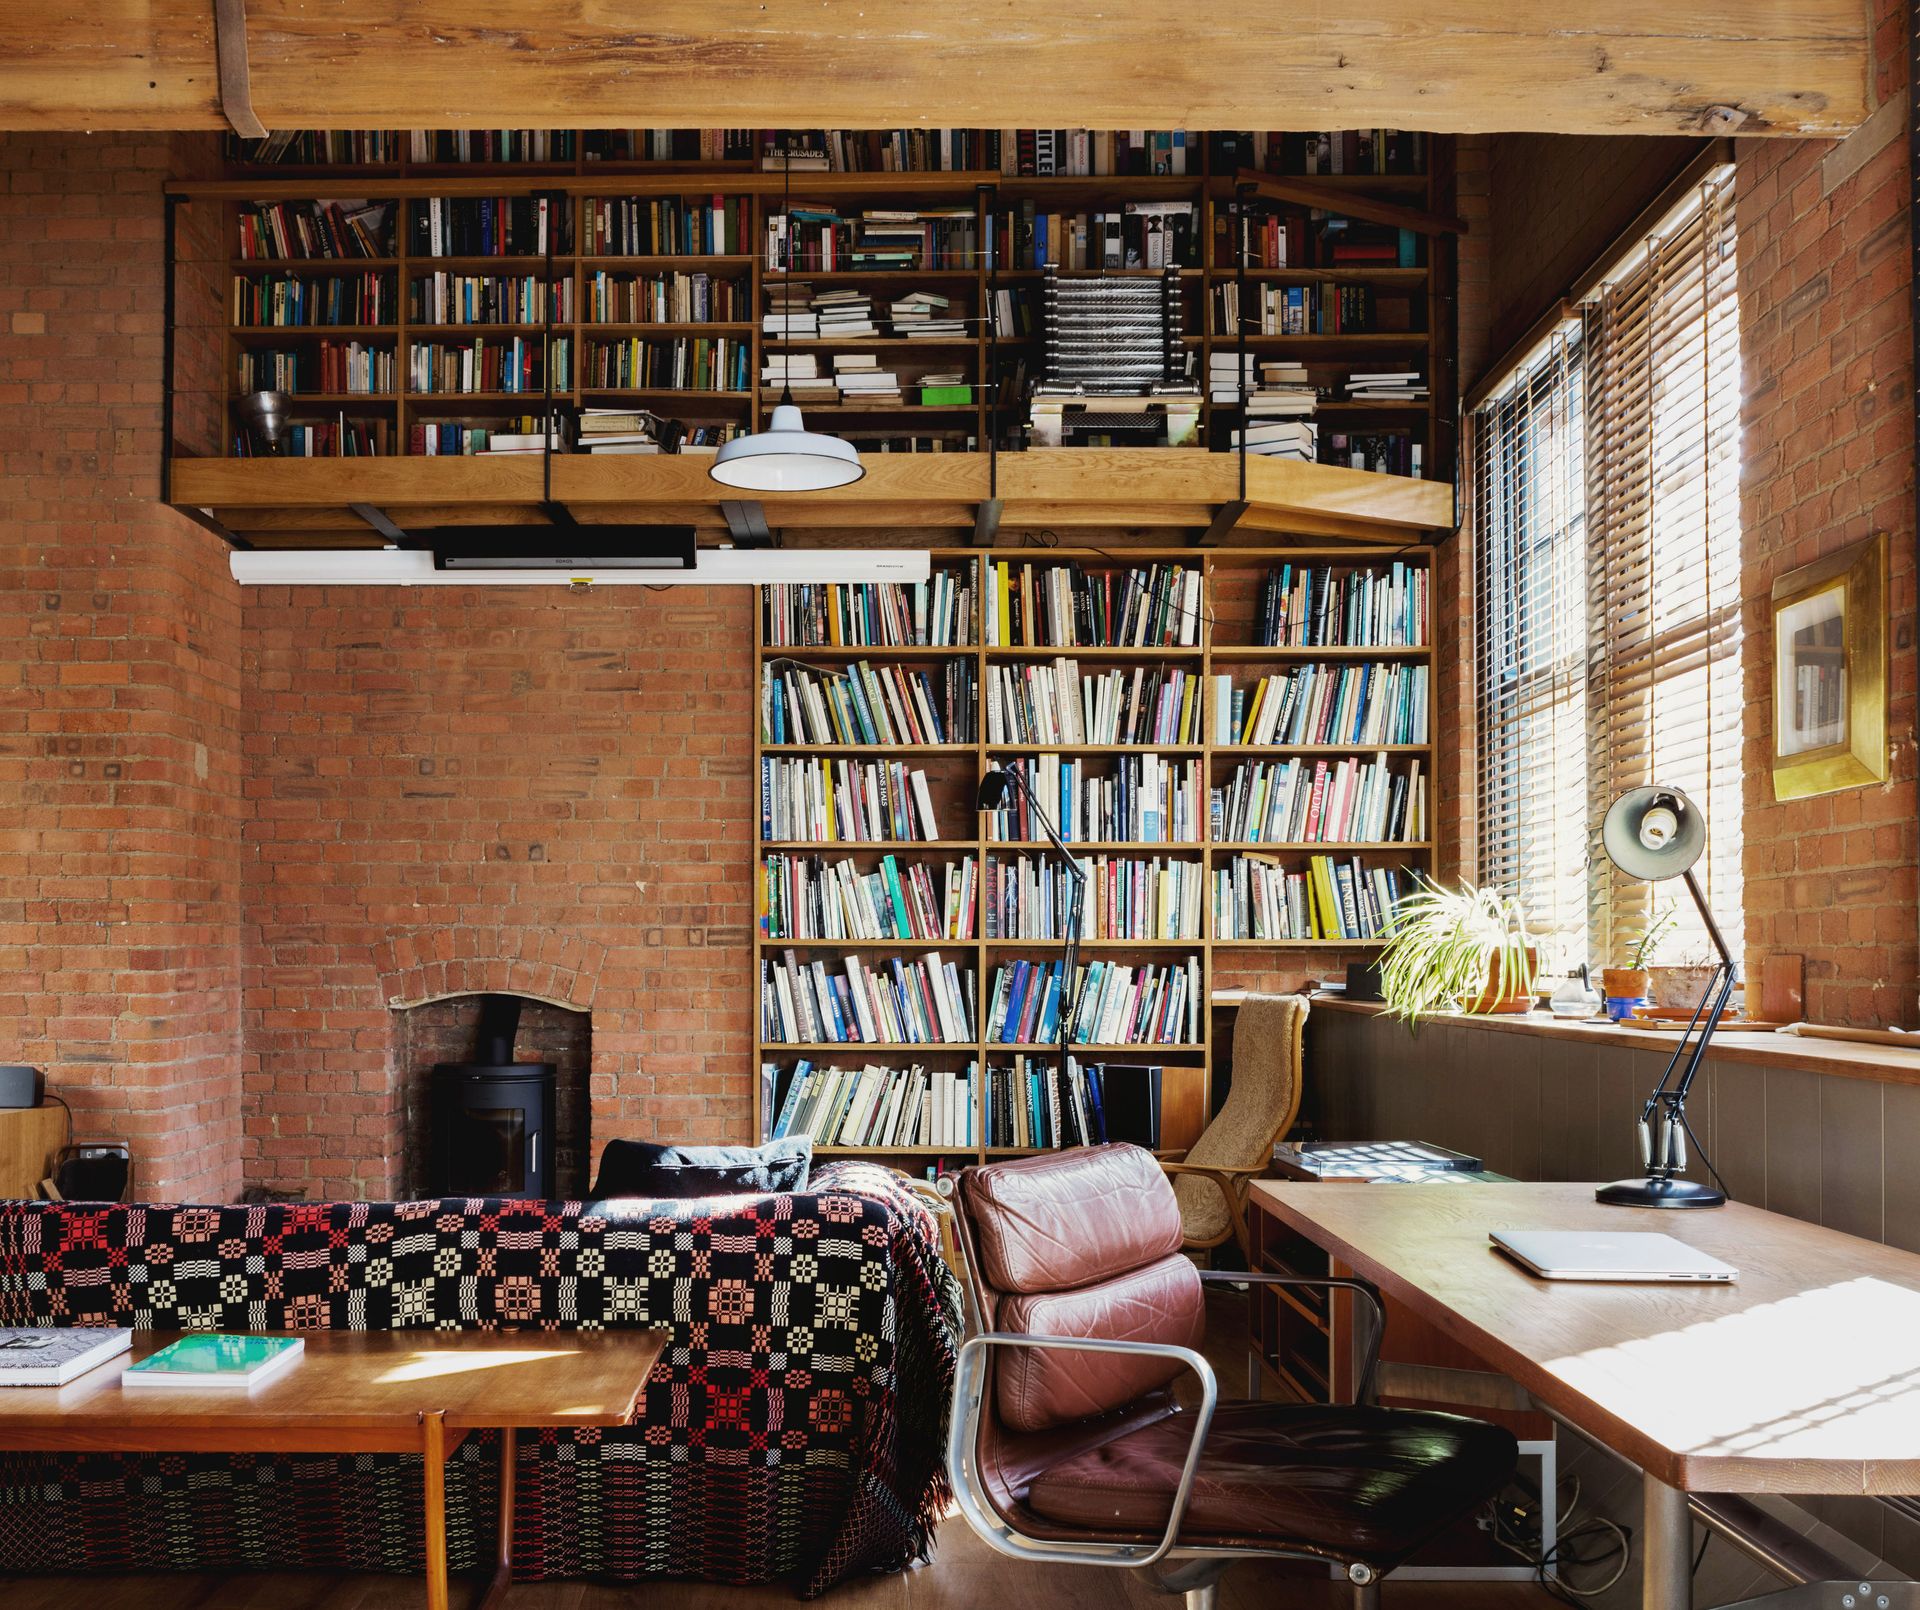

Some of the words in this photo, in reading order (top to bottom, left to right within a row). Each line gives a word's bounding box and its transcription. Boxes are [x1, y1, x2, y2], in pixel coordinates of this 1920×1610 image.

[878, 764, 887, 786] FRANS
[1310, 764, 1326, 819] PALLADIO
[763, 786, 771, 813] ERNST
[880, 787, 888, 807] HALS
[986, 867, 997, 909] AFRICA
[1341, 882, 1358, 929] ENGLISH
[787, 956, 798, 989] LEONARDO
[1025, 1067, 1034, 1112] RENAISSANCE
[1049, 1066, 1061, 1148] RENAISSANCE
